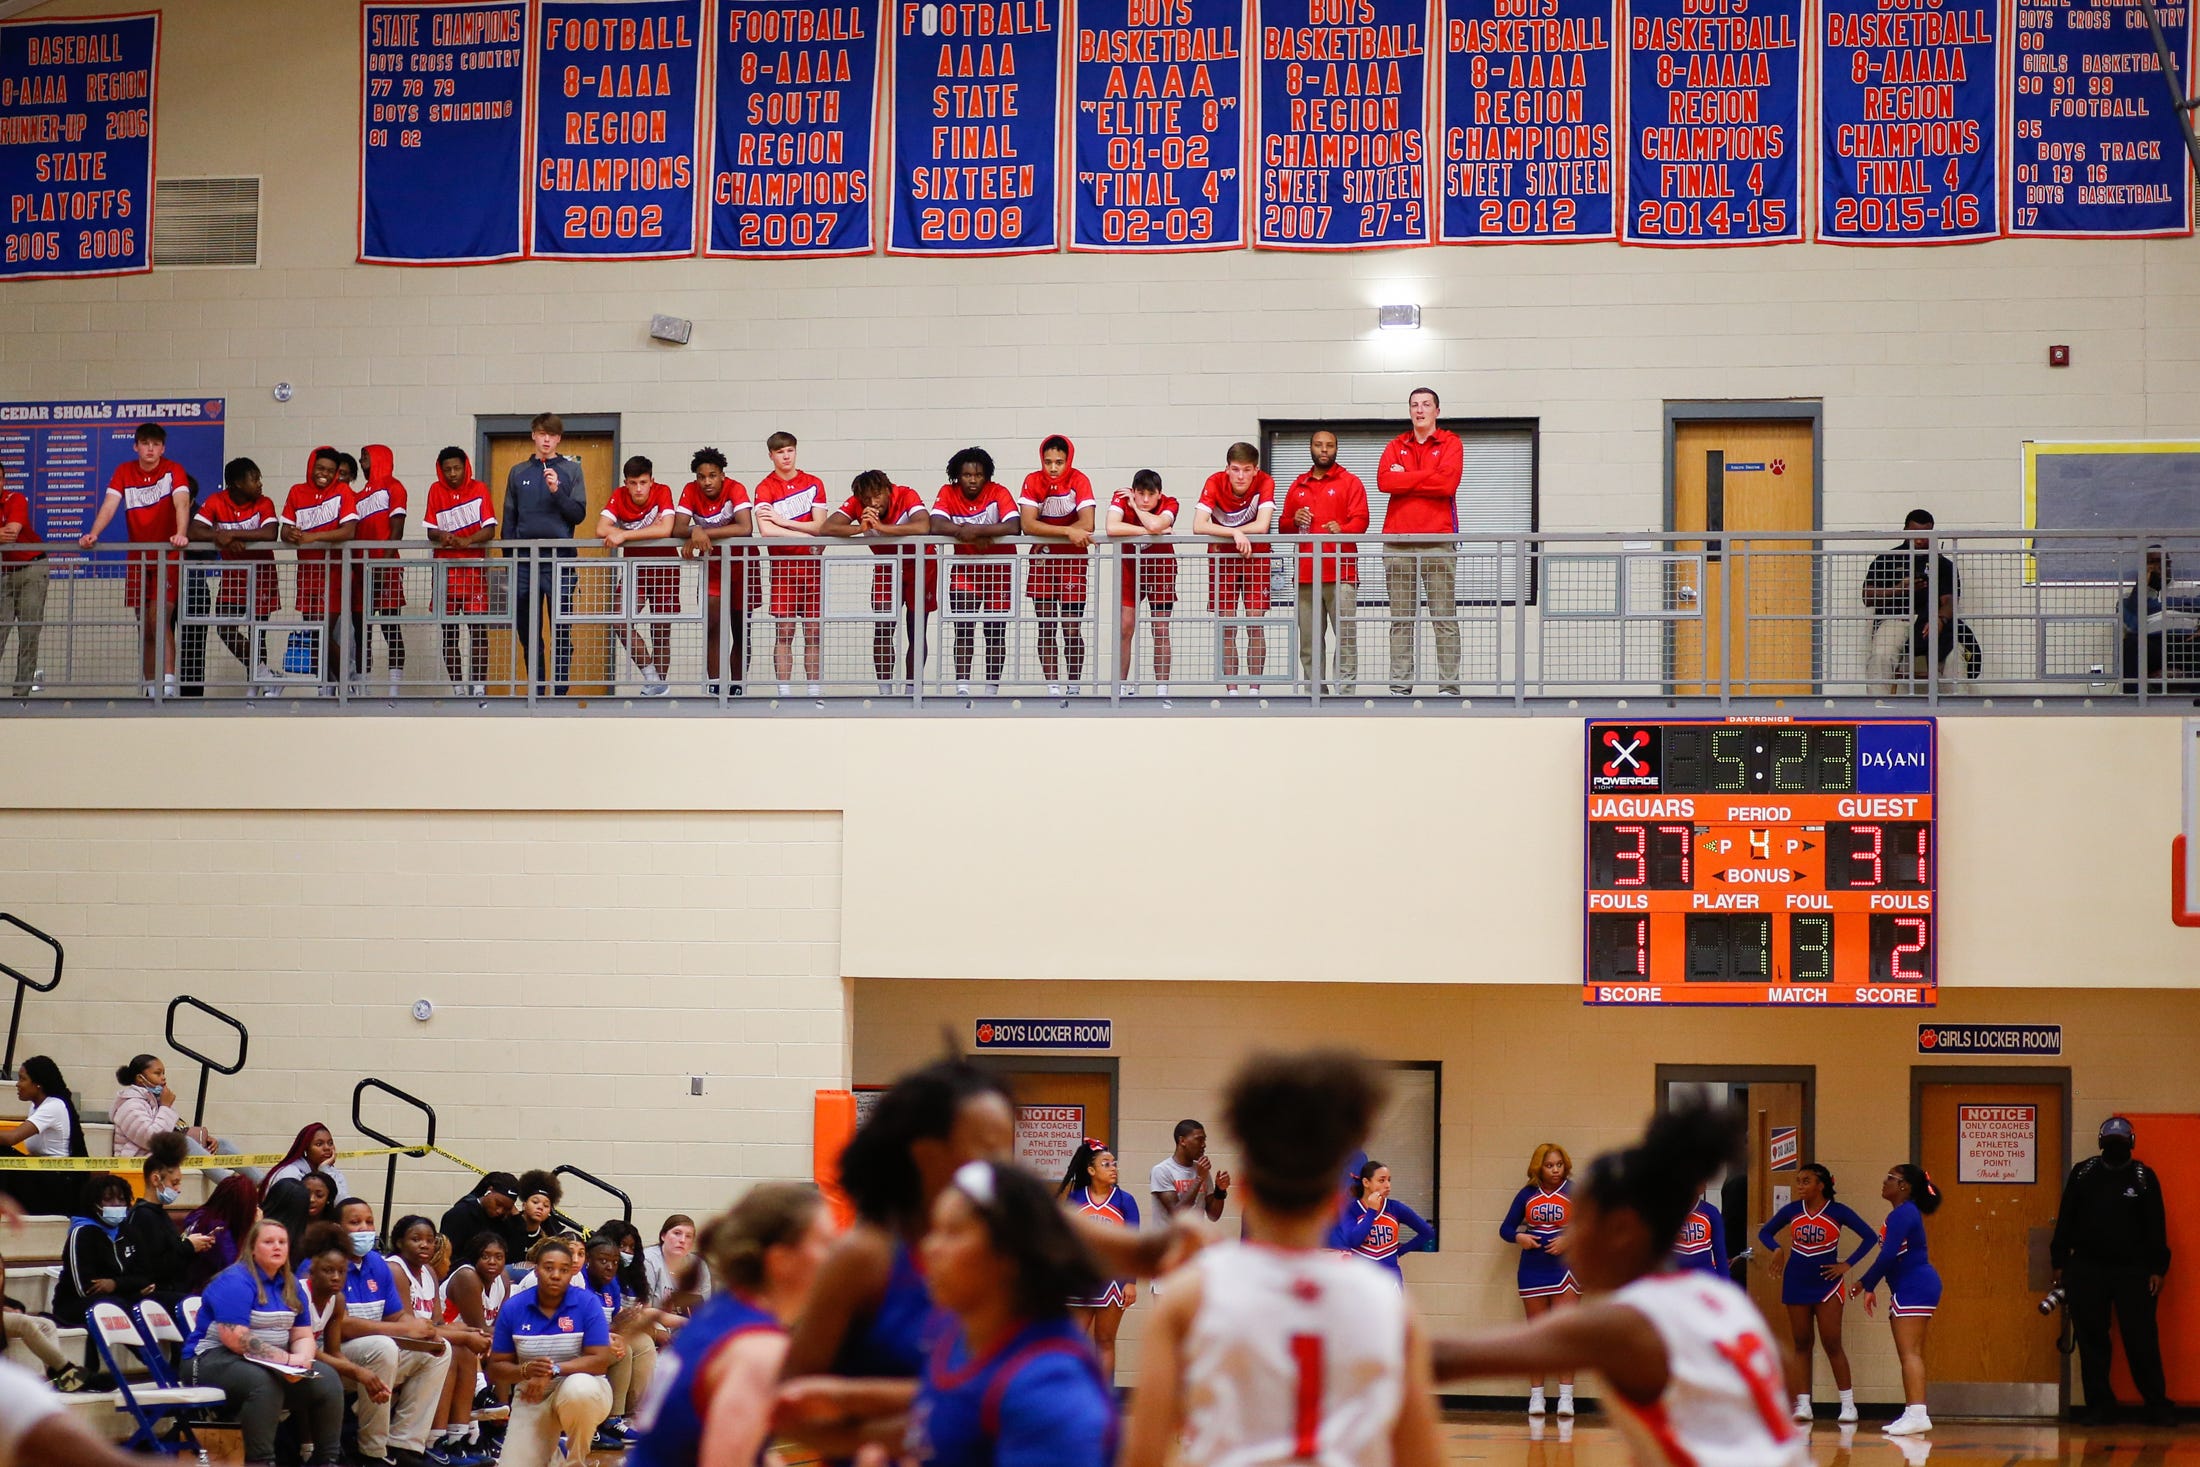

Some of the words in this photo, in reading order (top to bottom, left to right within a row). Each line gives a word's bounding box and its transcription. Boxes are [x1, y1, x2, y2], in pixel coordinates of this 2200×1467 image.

[372, 14, 420, 46] STATE
[433, 9, 520, 46] CHAMPIONS
[547, 16, 692, 51] FOOTBALL
[730, 7, 864, 43] FOOTBALL
[902, 0, 1051, 36] FOOTBALL
[1633, 15, 1796, 51] BASKETBALL
[1828, 10, 1992, 48] BASKETBALL
[2019, 10, 2053, 28] BOYS
[2068, 10, 2110, 29] CROSS
[28, 34, 122, 65] BASEBALL
[1080, 26, 1238, 63] BASKETBALL
[1264, 24, 1423, 60] BASKETBALL
[1450, 17, 1608, 54] BASKETBALL
[2020, 32, 2044, 50] 80
[370, 54, 403, 72] BOYS
[411, 53, 453, 71] CROSS
[460, 49, 520, 70] COUNTRY
[741, 50, 851, 84] 8-AAAA
[937, 43, 1015, 77] AAAA
[1471, 54, 1586, 88] 8-AAAA
[1657, 52, 1770, 88] 8-AAAAA
[1852, 48, 1966, 84] 8-AAAAA
[2024, 54, 2068, 72] GIRLS
[2082, 52, 2179, 73] BASKETBAL
[87, 70, 147, 102] REGION
[371, 79, 392, 97] 77
[403, 79, 424, 97] 78
[434, 79, 455, 97] 79
[564, 63, 671, 98] 8-AAAA
[1104, 64, 1214, 98] AAAA
[1286, 61, 1402, 96] 8-AAAA
[2018, 76, 2043, 94] 90
[2054, 76, 2074, 94] 91
[2089, 76, 2114, 94] 99
[374, 104, 419, 122] BOYS
[429, 100, 512, 122] SWIMMING
[747, 90, 840, 125] SOUTH
[933, 84, 1018, 118] STATE
[1290, 98, 1399, 132] REGION
[1475, 90, 1583, 124] REGION
[1668, 90, 1758, 124] REGION
[1864, 85, 1954, 120] REGION
[2050, 98, 2150, 118] FOOTBALL
[0, 113, 87, 144] RUNNER-UP
[106, 109, 147, 140] 2006
[369, 129, 387, 146] 81
[401, 130, 421, 147] 82
[565, 110, 666, 144] REGION
[932, 125, 1017, 160] FINAL
[1448, 124, 1609, 160] CHAMPIONS
[1642, 125, 1784, 160] CHAMPIONS
[1838, 120, 1980, 158] CHAMPIONS
[2018, 120, 2042, 138] 95
[738, 131, 843, 166] REGION
[1108, 135, 1209, 170] 01-02
[1265, 129, 1421, 168] CHAMPIONS
[2038, 142, 2086, 161] BOYS
[2100, 141, 2160, 161] TRACK
[36, 152, 106, 181] STATE
[540, 156, 690, 191] CHAMPIONS
[912, 165, 1034, 200] SIXTEEN
[1264, 169, 1328, 203] SWEET
[1343, 164, 1422, 203] SIXTEEN
[1448, 163, 1512, 197] SWEET
[1526, 160, 1610, 196] SIXTEEN
[1660, 164, 1734, 198] FINAL
[1747, 163, 1764, 196] 4
[1858, 160, 1931, 194] FINAL
[1944, 158, 1958, 192] 4
[2017, 164, 2038, 183] 01
[2053, 164, 2073, 183] 13
[2087, 164, 2108, 183] 16
[715, 170, 867, 206] CHAMPIONS
[2026, 186, 2064, 204] BOYS
[2078, 184, 2172, 204] BASKETBALL
[12, 189, 130, 223] PLAYOFFS
[564, 205, 662, 238] 2002
[921, 206, 1022, 240] 2008
[1264, 205, 1332, 238] 2007
[1360, 201, 1421, 238] 27-2
[1480, 198, 1576, 233] 2012
[1638, 200, 1786, 235] 2014-15
[1835, 194, 1979, 232] 2015-16
[2017, 208, 2038, 226] 17
[740, 213, 837, 246] 2007
[1102, 207, 1212, 242] 02-03
[6, 232, 59, 263] 2005
[79, 228, 134, 259] 2006
[0, 406, 49, 420] CEDAR
[53, 405, 112, 420] SHOALS
[116, 403, 200, 418] ATHLETICS
[1712, 730, 1851, 789] 5:23
[1862, 748, 1925, 770] DASANI
[1594, 777, 1658, 785] POWERADE
[1591, 798, 1695, 818] JAGUARS
[1728, 807, 1792, 821] PERIOD
[1838, 798, 1918, 817] GUEST
[1614, 826, 1690, 885] 37
[1720, 840, 1732, 854] P
[1750, 830, 1770, 859] 4
[1787, 840, 1798, 854] P
[1850, 826, 1926, 886] 31
[1728, 868, 1790, 883] BONUS
[1590, 894, 1648, 909] FOULS
[1692, 894, 1760, 909] PLAYER
[1786, 894, 1833, 909] FOUL
[1870, 894, 1930, 909] FOULS
[1638, 920, 1645, 975] 1
[1798, 918, 1828, 978] 3
[1892, 918, 1926, 979] 2
[1600, 988, 1662, 1002] SCORE
[1768, 988, 1826, 1002] MATCH
[1856, 989, 1918, 1002] SCORE
[994, 1025, 1025, 1042] BOYS
[1028, 1026, 1072, 1042] LOCKER
[1075, 1026, 1110, 1042] ROOM
[1938, 1030, 1972, 1047] GIRLS
[1974, 1031, 2020, 1048] LOCKER
[2022, 1032, 2060, 1048] ROOM
[1022, 1110, 1075, 1120] NOTICE
[1965, 1122, 1986, 1130] ONLY
[1989, 1122, 2030, 1130] COACHES
[1968, 1109, 2027, 1120] NOTICE
[1970, 1150, 2004, 1158] BEYOND
[2007, 1150, 2025, 1158] THIS
[1531, 1203, 1564, 1222] CSHS
[1794, 1224, 1826, 1243] CSHS
